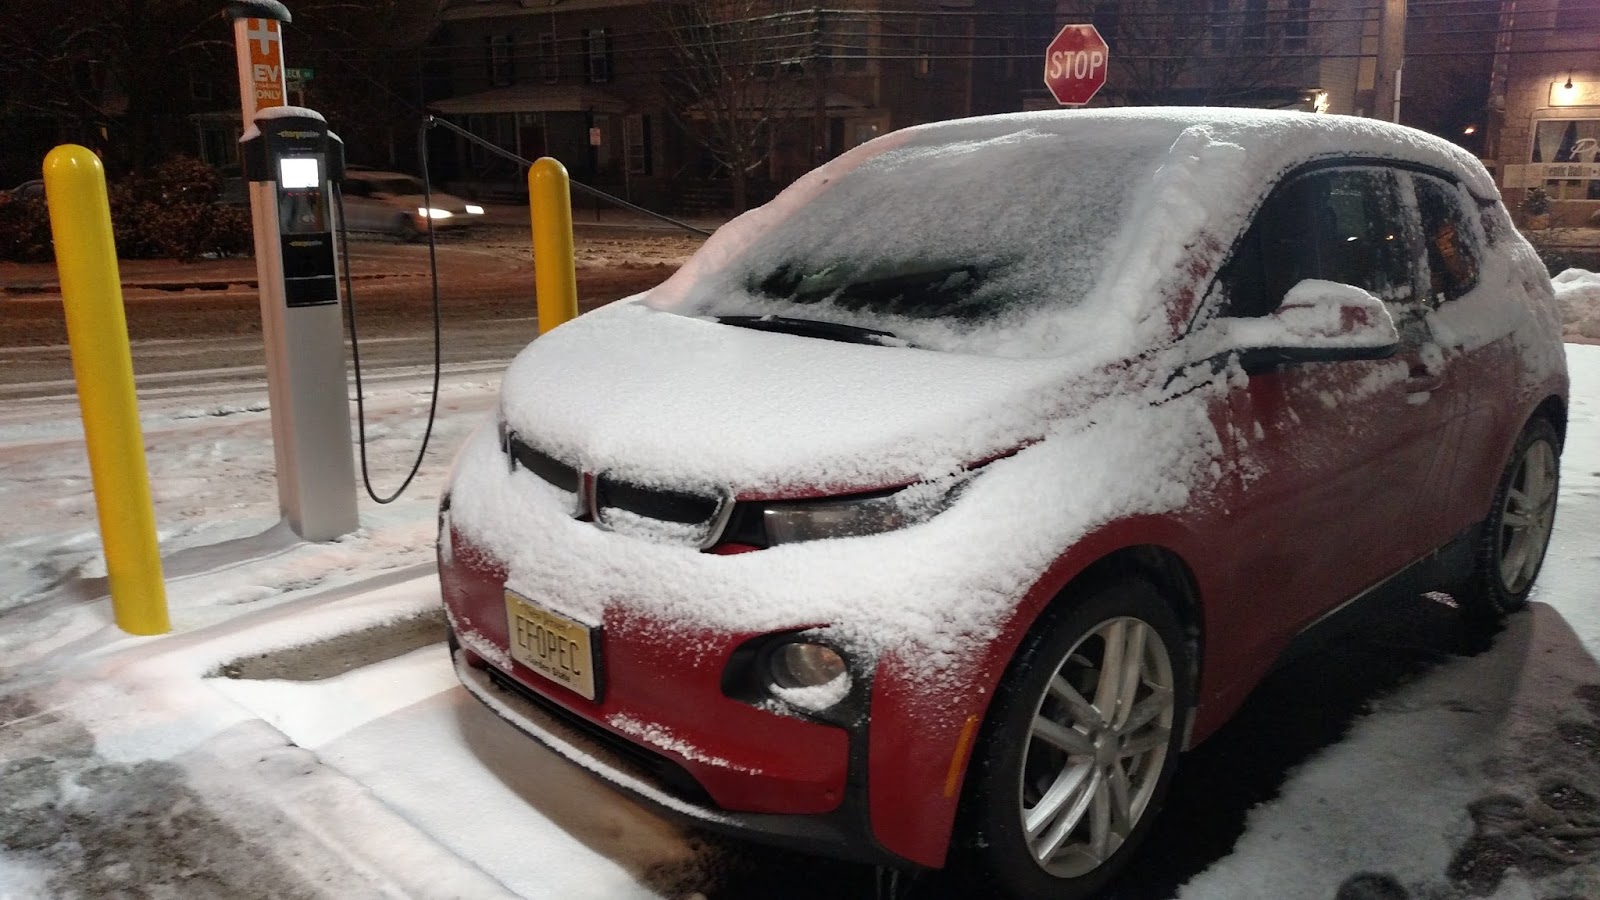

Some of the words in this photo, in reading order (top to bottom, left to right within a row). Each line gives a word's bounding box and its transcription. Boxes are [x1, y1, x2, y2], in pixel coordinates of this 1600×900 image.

[253, 64, 279, 82] EV
[1050, 50, 1103, 80] STOP
[257, 89, 281, 100] ONLY
